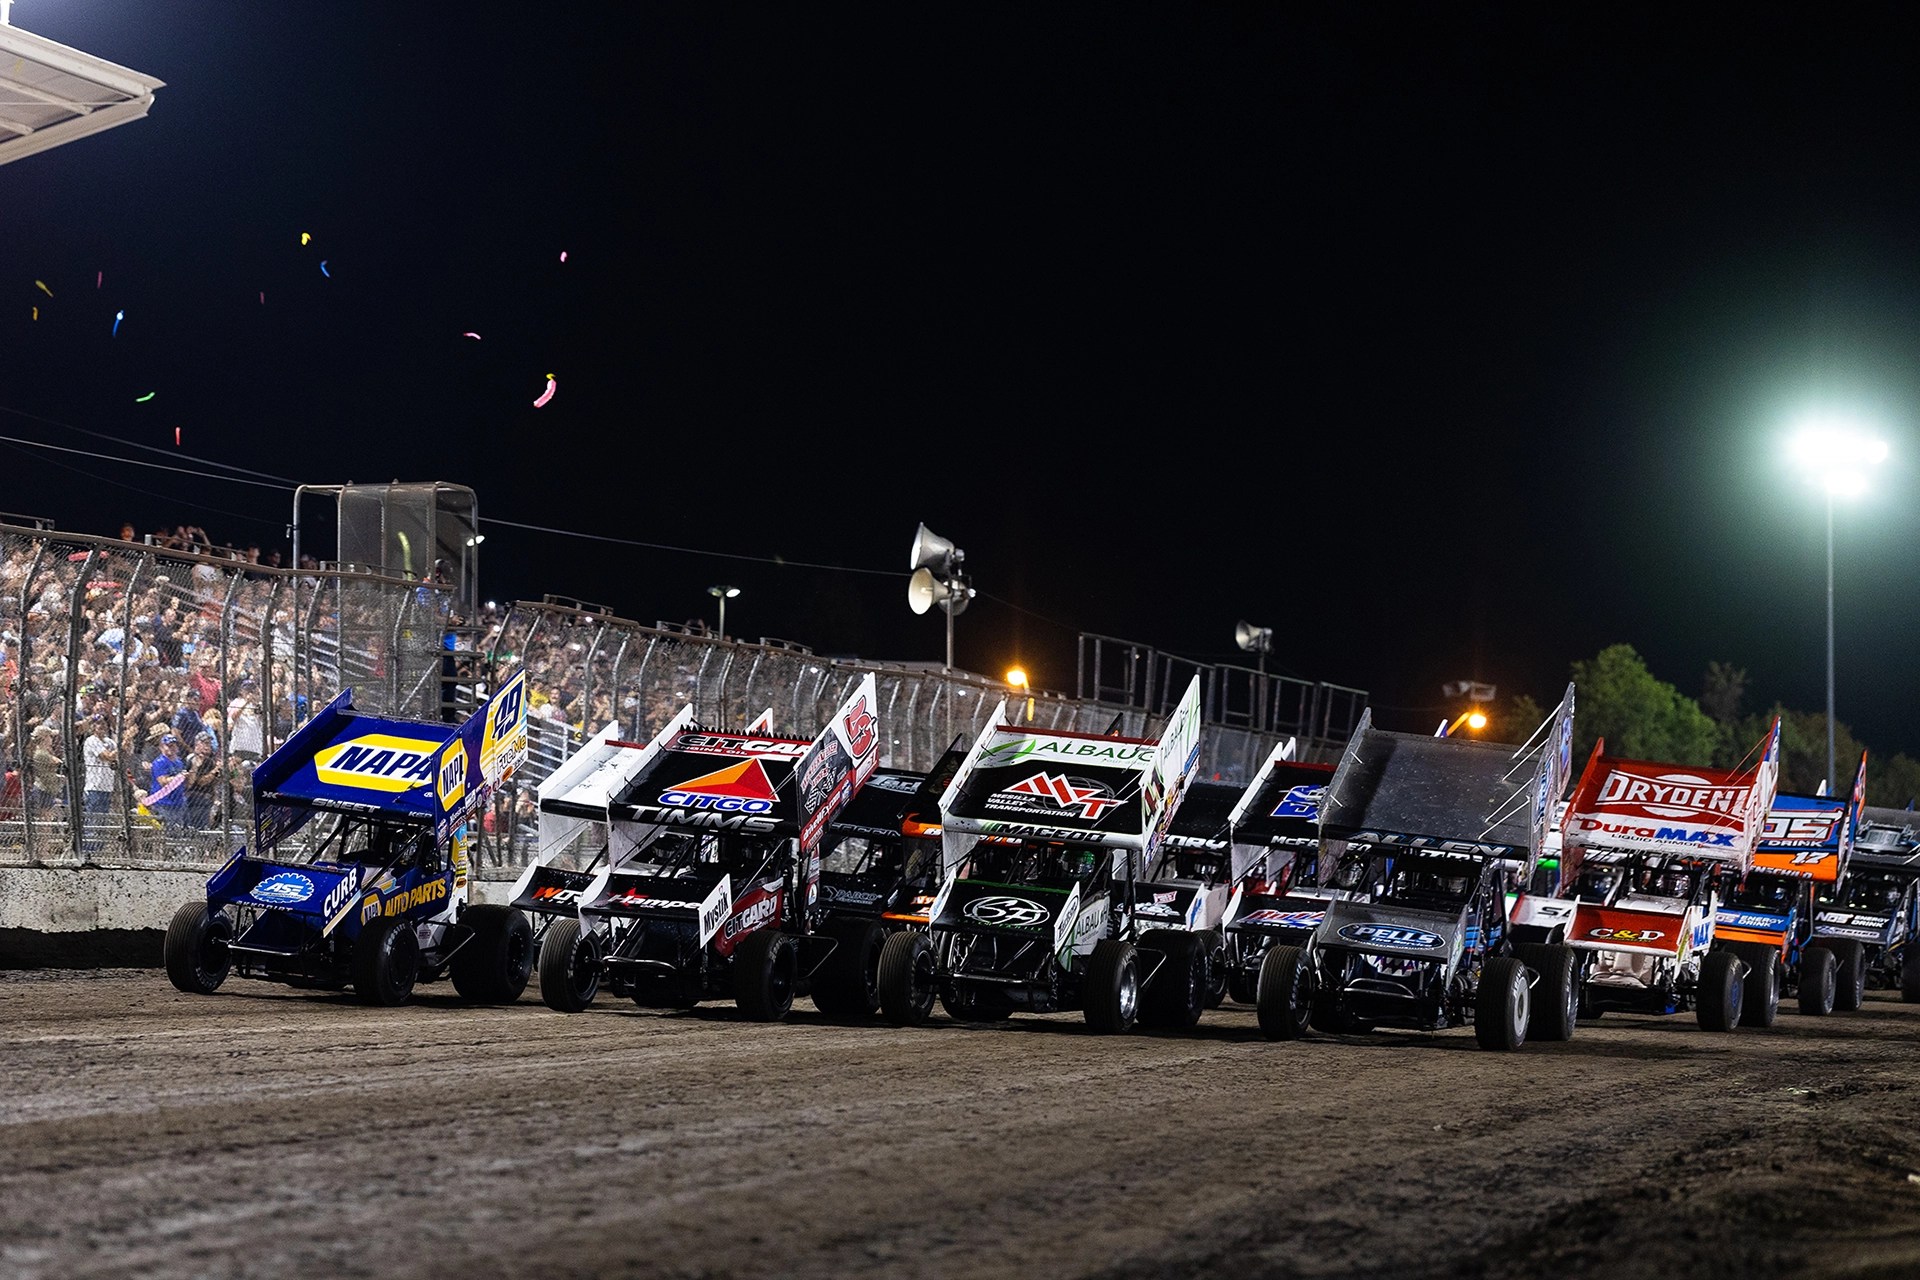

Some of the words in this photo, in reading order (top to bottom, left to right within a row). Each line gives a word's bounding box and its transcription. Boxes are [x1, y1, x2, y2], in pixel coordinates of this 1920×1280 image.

[492, 680, 524, 741] 49
[671, 745, 723, 754] ENGINE
[1037, 742, 1156, 762] ALBAUG
[658, 791, 773, 814] CITGO
[987, 798, 1026, 806] VALLEY
[990, 793, 1036, 802] MESILLA
[312, 798, 381, 813] SWEET
[984, 804, 1077, 818] TRANSPORTATION
[627, 805, 784, 833] TIMMS
[1760, 810, 1844, 840] OS
[1000, 824, 1107, 843] MACEDO
[1579, 818, 1736, 847] DuraMAX
[1347, 830, 1514, 857] ALLEN
[1612, 833, 1652, 842] LIQUID
[1655, 838, 1704, 848] ARMOR
[1768, 840, 1823, 848] DRINK
[1791, 852, 1830, 865] 17
[264, 883, 304, 896] ASE
[323, 867, 357, 917] CURB
[384, 891, 409, 917] AUTO
[409, 878, 446, 908] PARTS
[607, 894, 702, 910] Hampe
[703, 891, 729, 936] Mystik
[724, 895, 778, 939] CITGARD
[1740, 915, 1785, 925] ENERGY
[1815, 912, 1854, 924] NOS
[1855, 915, 1890, 924] ENERGY
[1738, 919, 1771, 928] DRINK
[1851, 919, 1885, 928] DRINK
[1356, 926, 1437, 944] PELLS
[1590, 928, 1665, 941] C&D
